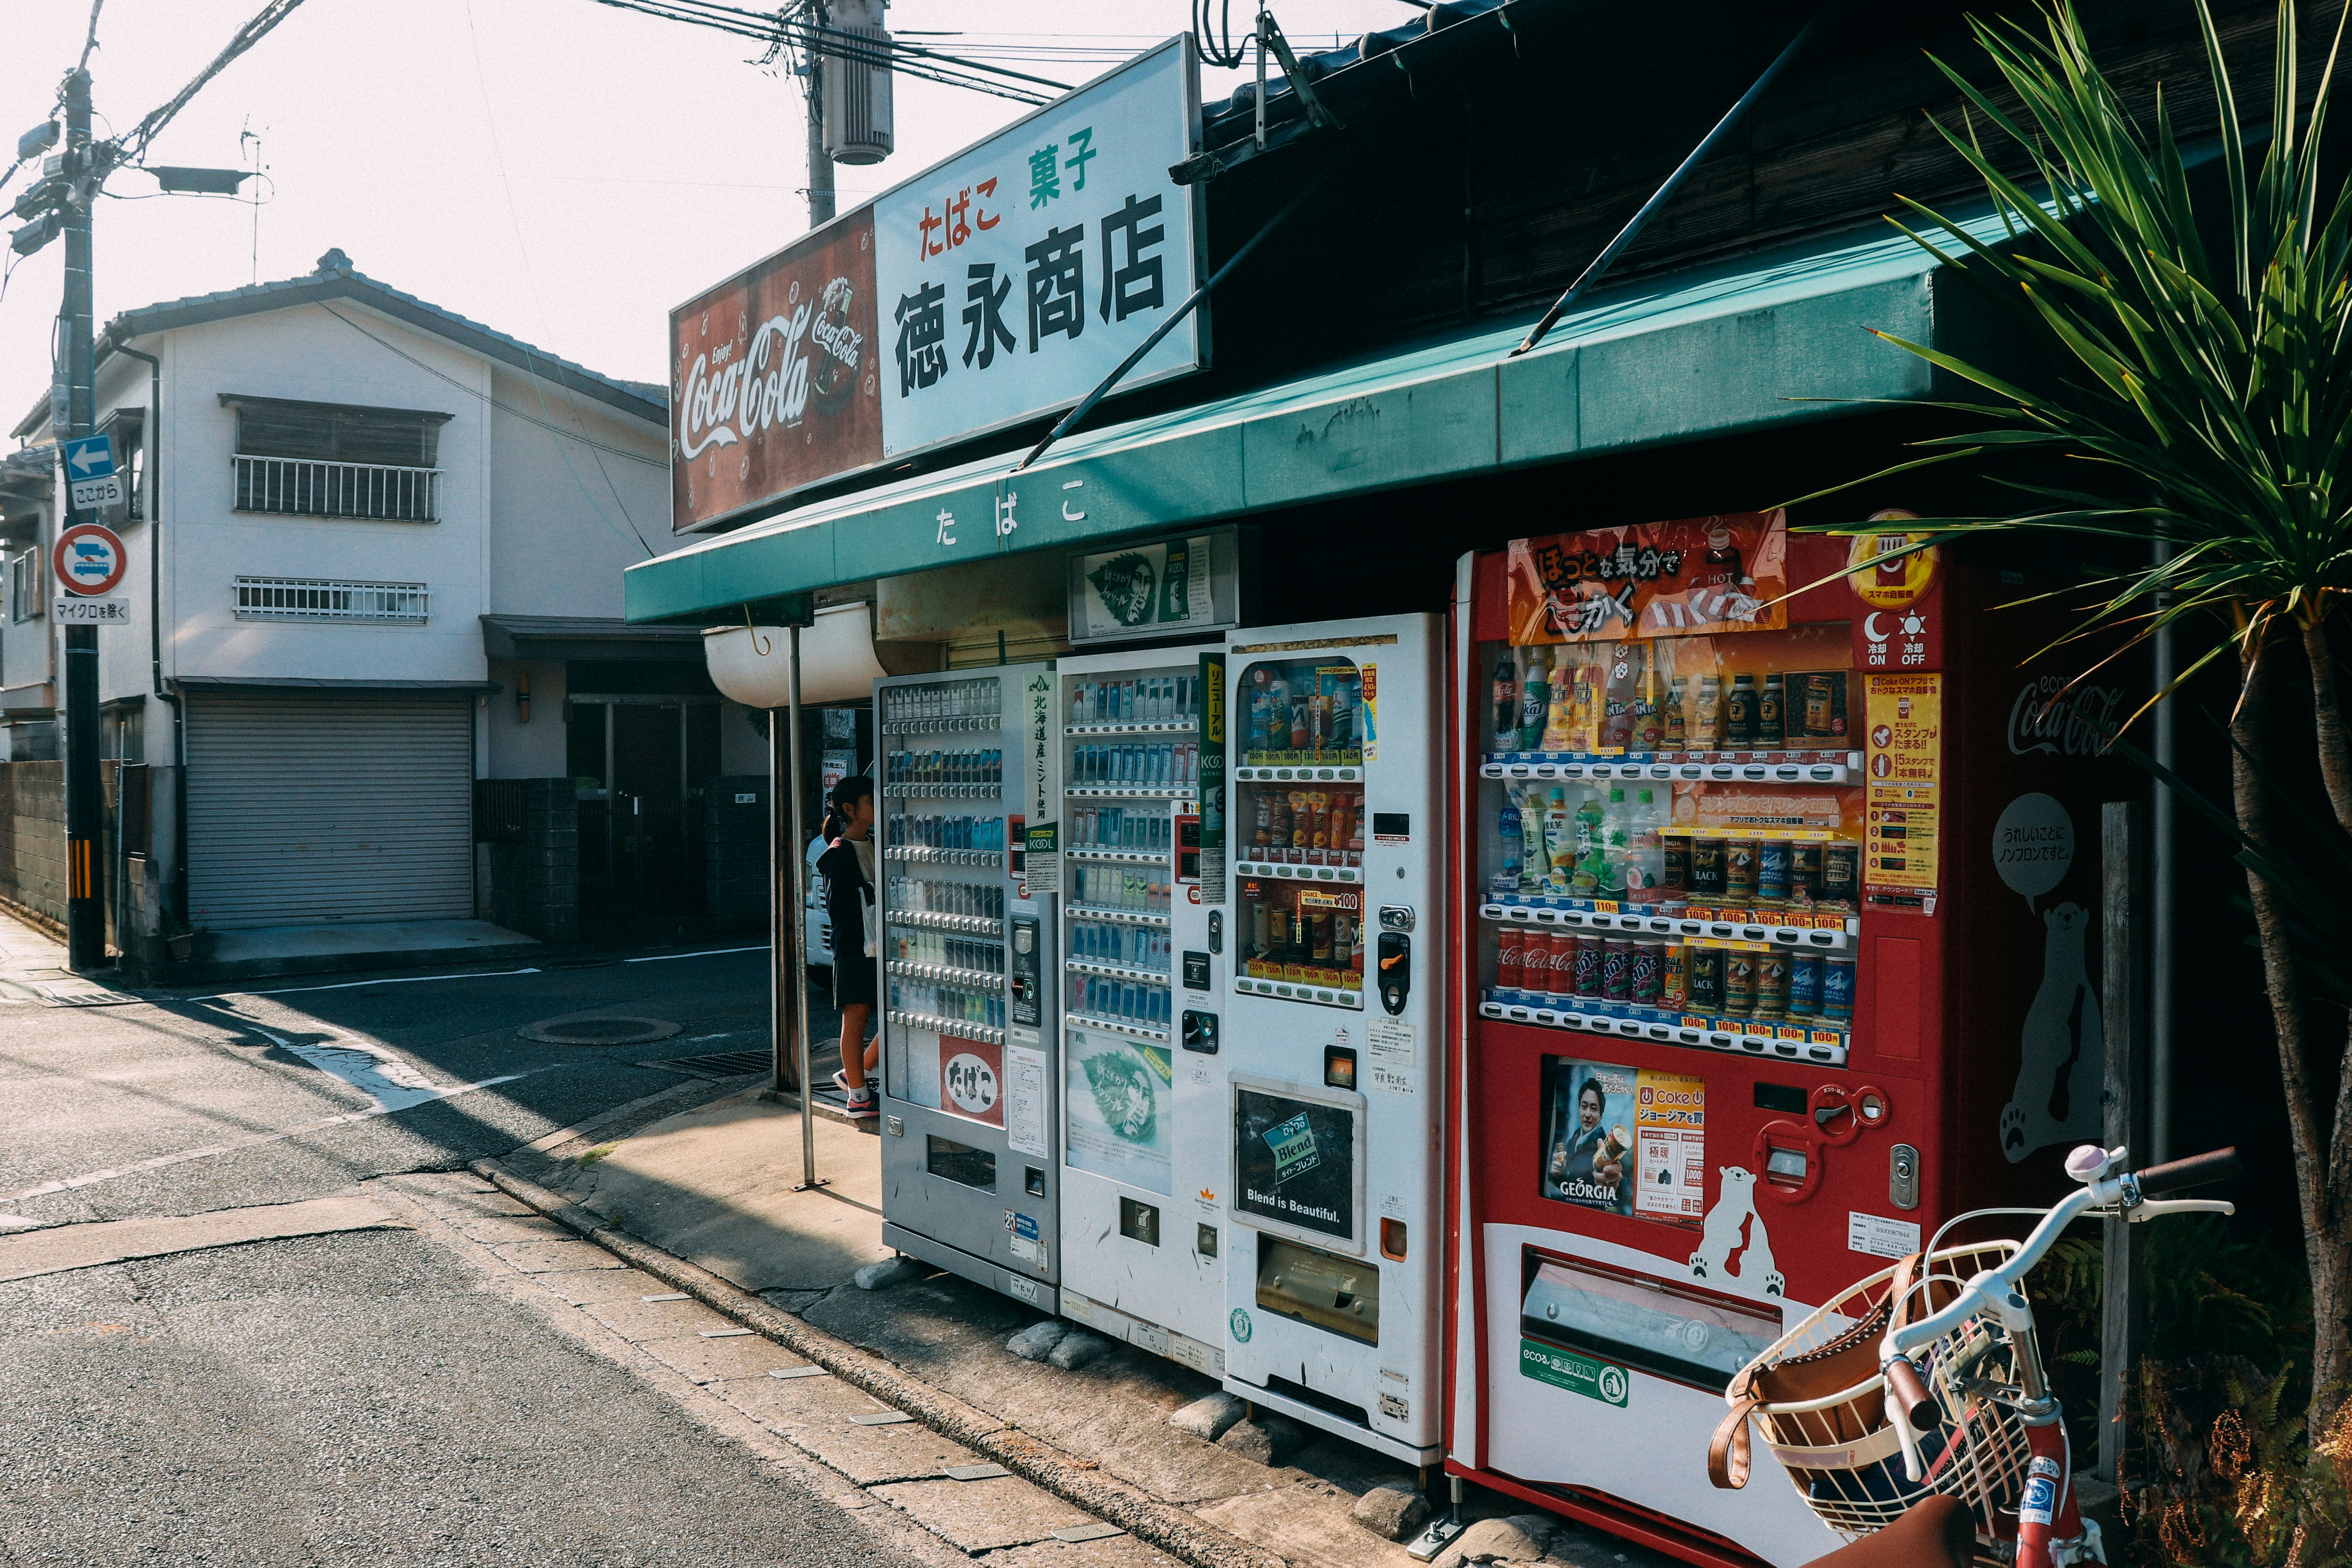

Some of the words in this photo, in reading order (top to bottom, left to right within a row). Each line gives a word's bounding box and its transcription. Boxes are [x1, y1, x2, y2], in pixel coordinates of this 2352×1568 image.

[919, 176, 1000, 263] たばこ
[1028, 125, 1097, 212] 菓子
[894, 192, 1165, 399] 徳永商店
[812, 311, 863, 367] Coca-Cola
[712, 339, 733, 365] Enjoy!
[681, 297, 813, 459] Coca-Cola
[76, 483, 118, 503] ここから
[936, 480, 1085, 546] たばこ
[1169, 562, 1185, 574] KOOL
[1708, 572, 1733, 584] HOT
[1868, 590, 1914, 599] スマホ自販機
[57, 603, 125, 619] マイクロを除く
[1868, 643, 1887, 653] 冷却
[1904, 643, 1923, 653] 冷却
[1869, 654, 1886, 665] ON
[1902, 654, 1926, 665] OFF
[1808, 690, 1827, 698] GEORGIA
[1211, 670, 1222, 736] リニューアル
[1034, 695, 1047, 819] 北海道産ミント使用
[1249, 751, 1263, 760] 100円
[1323, 752, 1337, 760] 140円
[1343, 751, 1358, 760] 140円
[1894, 753, 1935, 765] 15スタンプで
[2004, 826, 2065, 844] うれしいことに
[1029, 839, 1053, 849] KOOL
[1999, 845, 2069, 863] ノンフロンですと。
[1334, 894, 1356, 907] ¥100
[1595, 901, 1617, 912] 110円
[1688, 911, 1711, 920] 100円
[1722, 913, 1745, 922] 100円
[1757, 915, 1780, 925] 100円
[1787, 917, 1811, 927] 100円
[1817, 919, 1842, 928] 100円
[1249, 962, 1263, 971] 130円
[1266, 966, 1281, 975] 130円
[1286, 968, 1301, 976] 120円
[1304, 971, 1319, 979] 100円
[1323, 973, 1339, 982] 100円
[1344, 975, 1360, 984] 100円
[1682, 1018, 1706, 1027] 100円
[1717, 1022, 1740, 1032] 100円
[1747, 1024, 1771, 1035] 100円
[1779, 1028, 1803, 1039] 100円
[1813, 1032, 1838, 1042] 100円
[1147, 1049, 1169, 1076] リニューアル
[949, 1061, 992, 1105] たばこ
[1657, 1090, 1690, 1105] Coke
[1283, 1121, 1305, 1136] DyDo
[1277, 1135, 1313, 1162] Blend
[1649, 1145, 1669, 1159] 極暖
[1282, 1154, 1317, 1178] ダイドーブレンド
[1560, 1177, 1619, 1201] GEORGIA
[1247, 1189, 1275, 1207] Blend
[1278, 1196, 1286, 1209] is
[1289, 1199, 1340, 1223] Beautiful.
[1005, 1214, 1016, 1231] 20
[1875, 1227, 1909, 1238] 9300087844
